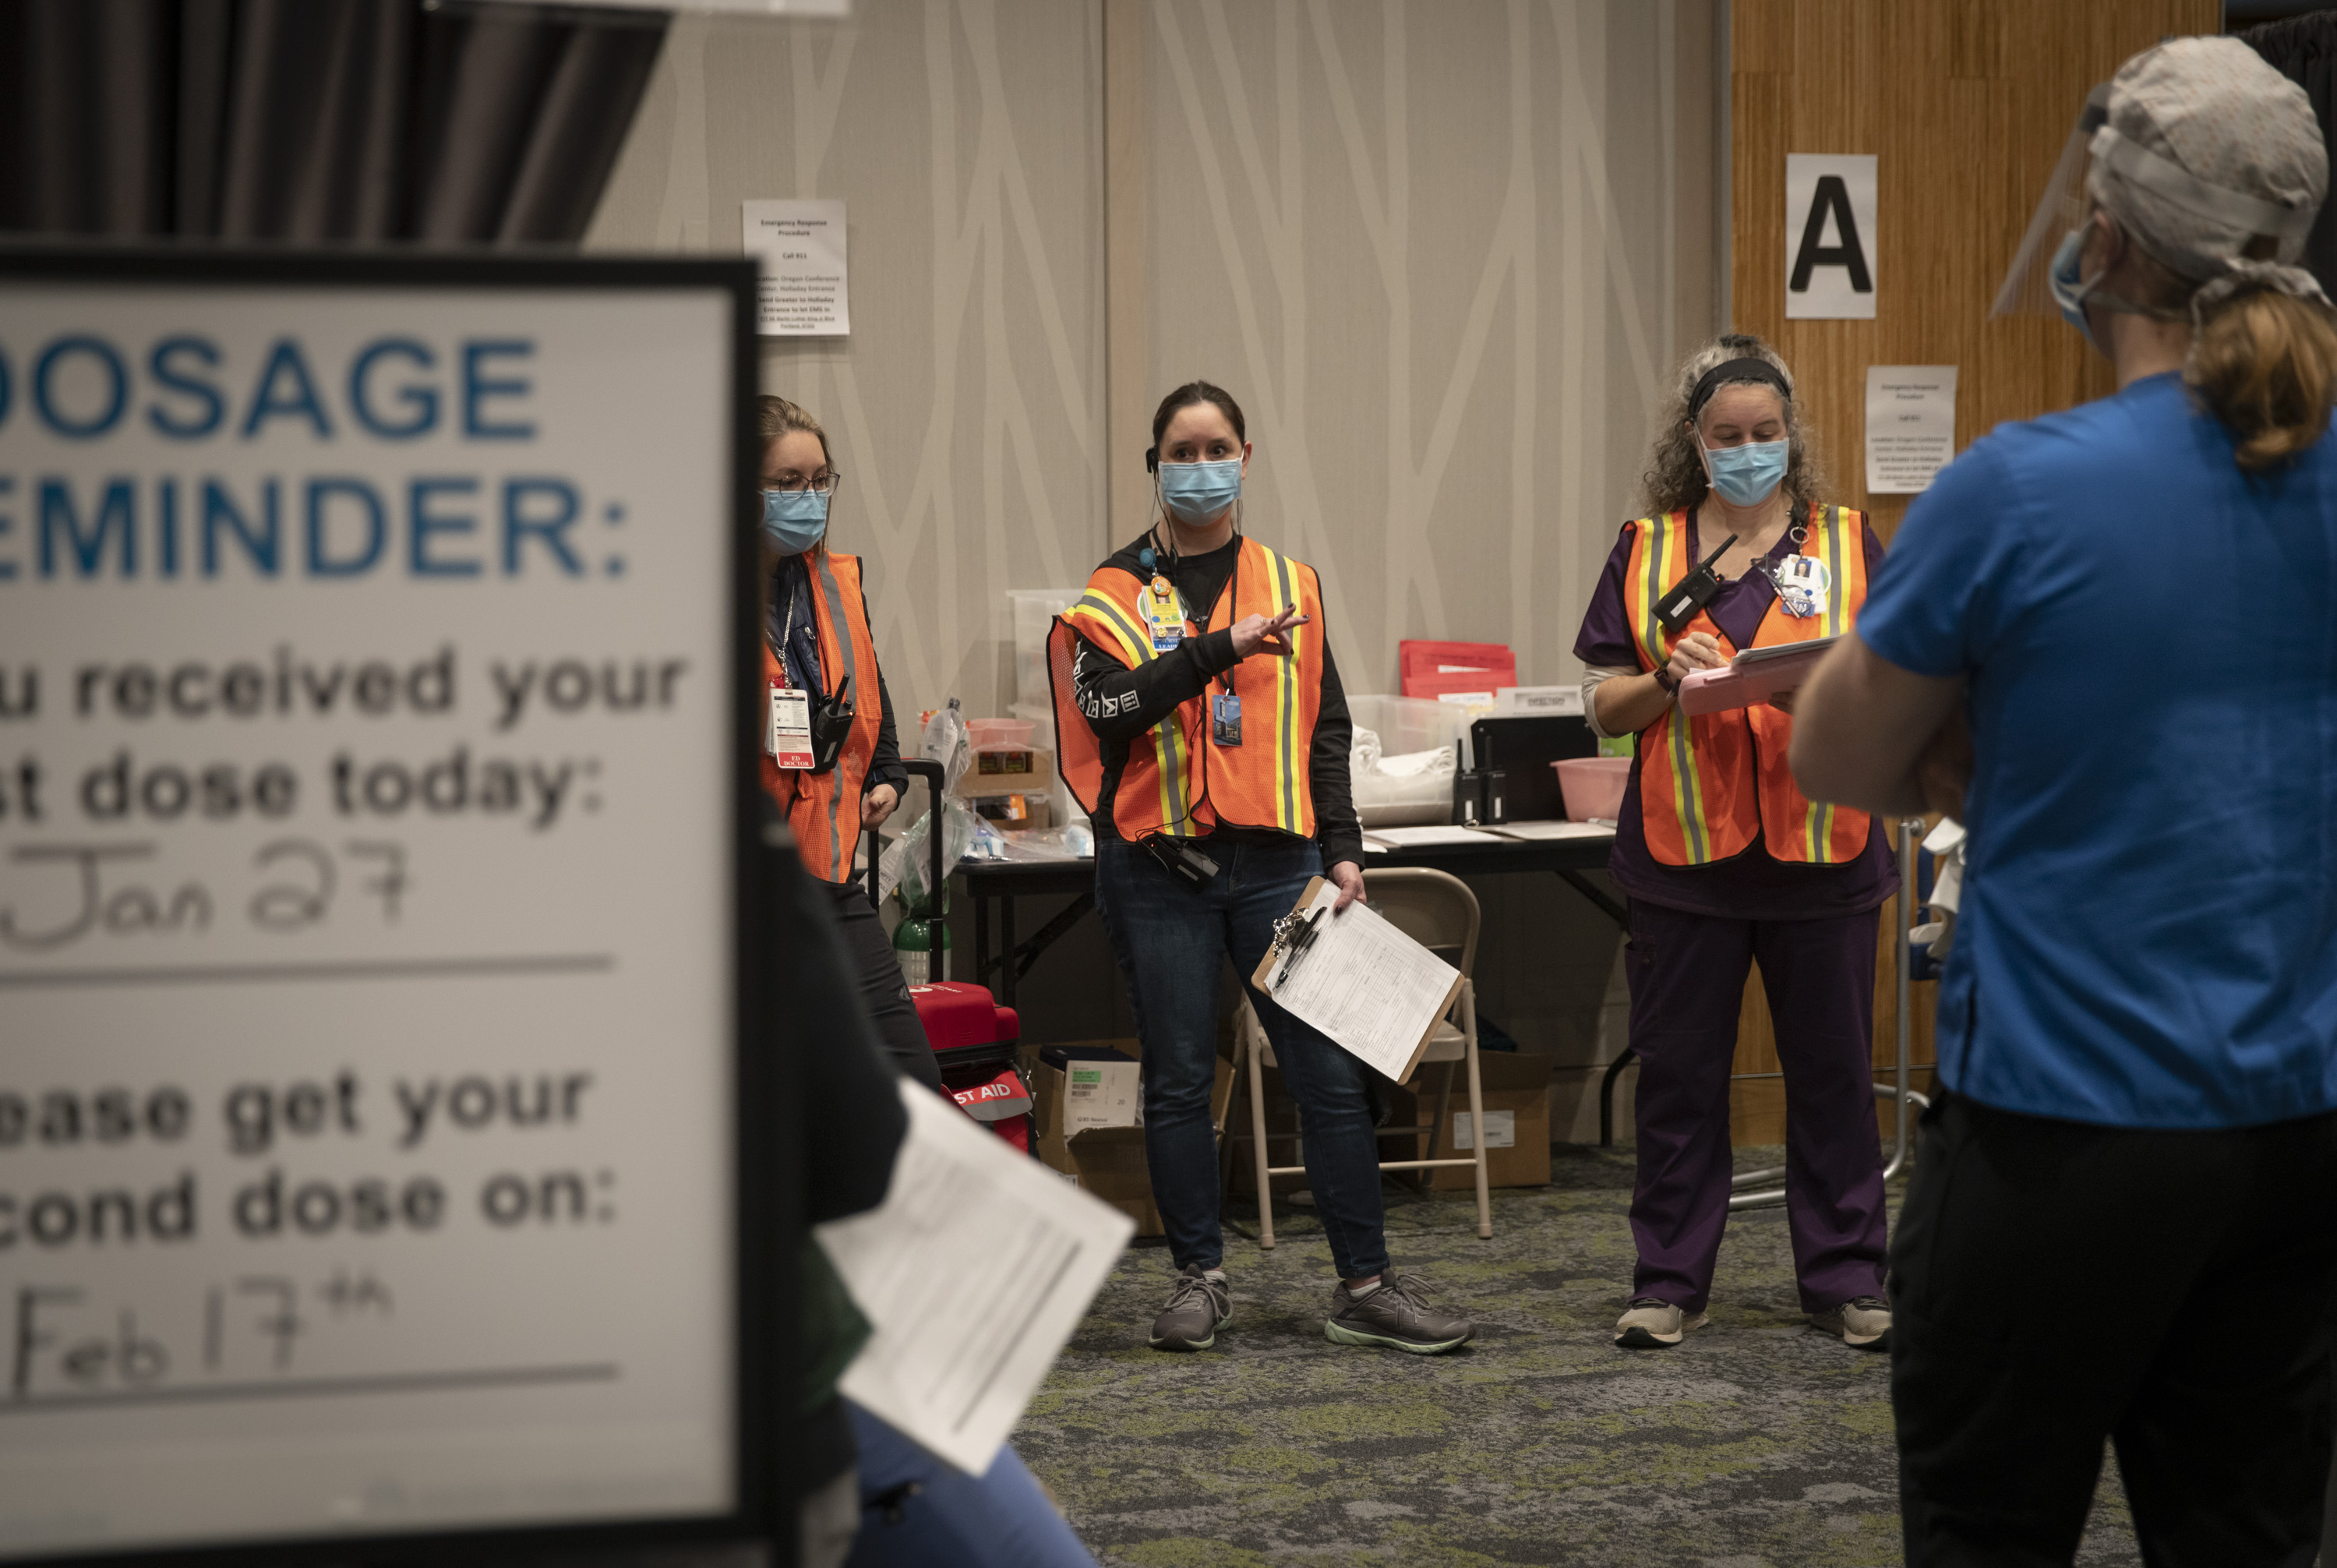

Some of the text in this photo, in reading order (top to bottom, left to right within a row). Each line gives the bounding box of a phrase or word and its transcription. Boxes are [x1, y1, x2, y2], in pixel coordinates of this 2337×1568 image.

[1790, 174, 1873, 293] A
[0, 331, 539, 443] OSAGE
[0, 475, 628, 583] MINDER:
[74, 645, 457, 721] received
[489, 654, 689, 733] your
[79, 750, 302, 821] dose
[330, 743, 604, 834] today:
[0, 836, 415, 952] Jan 27
[0, 1065, 593, 1158] ease get your
[981, 1083, 1011, 1099] AID
[231, 1166, 447, 1239] dose
[479, 1167, 615, 1230] on:
[11, 1284, 170, 1397] Feb
